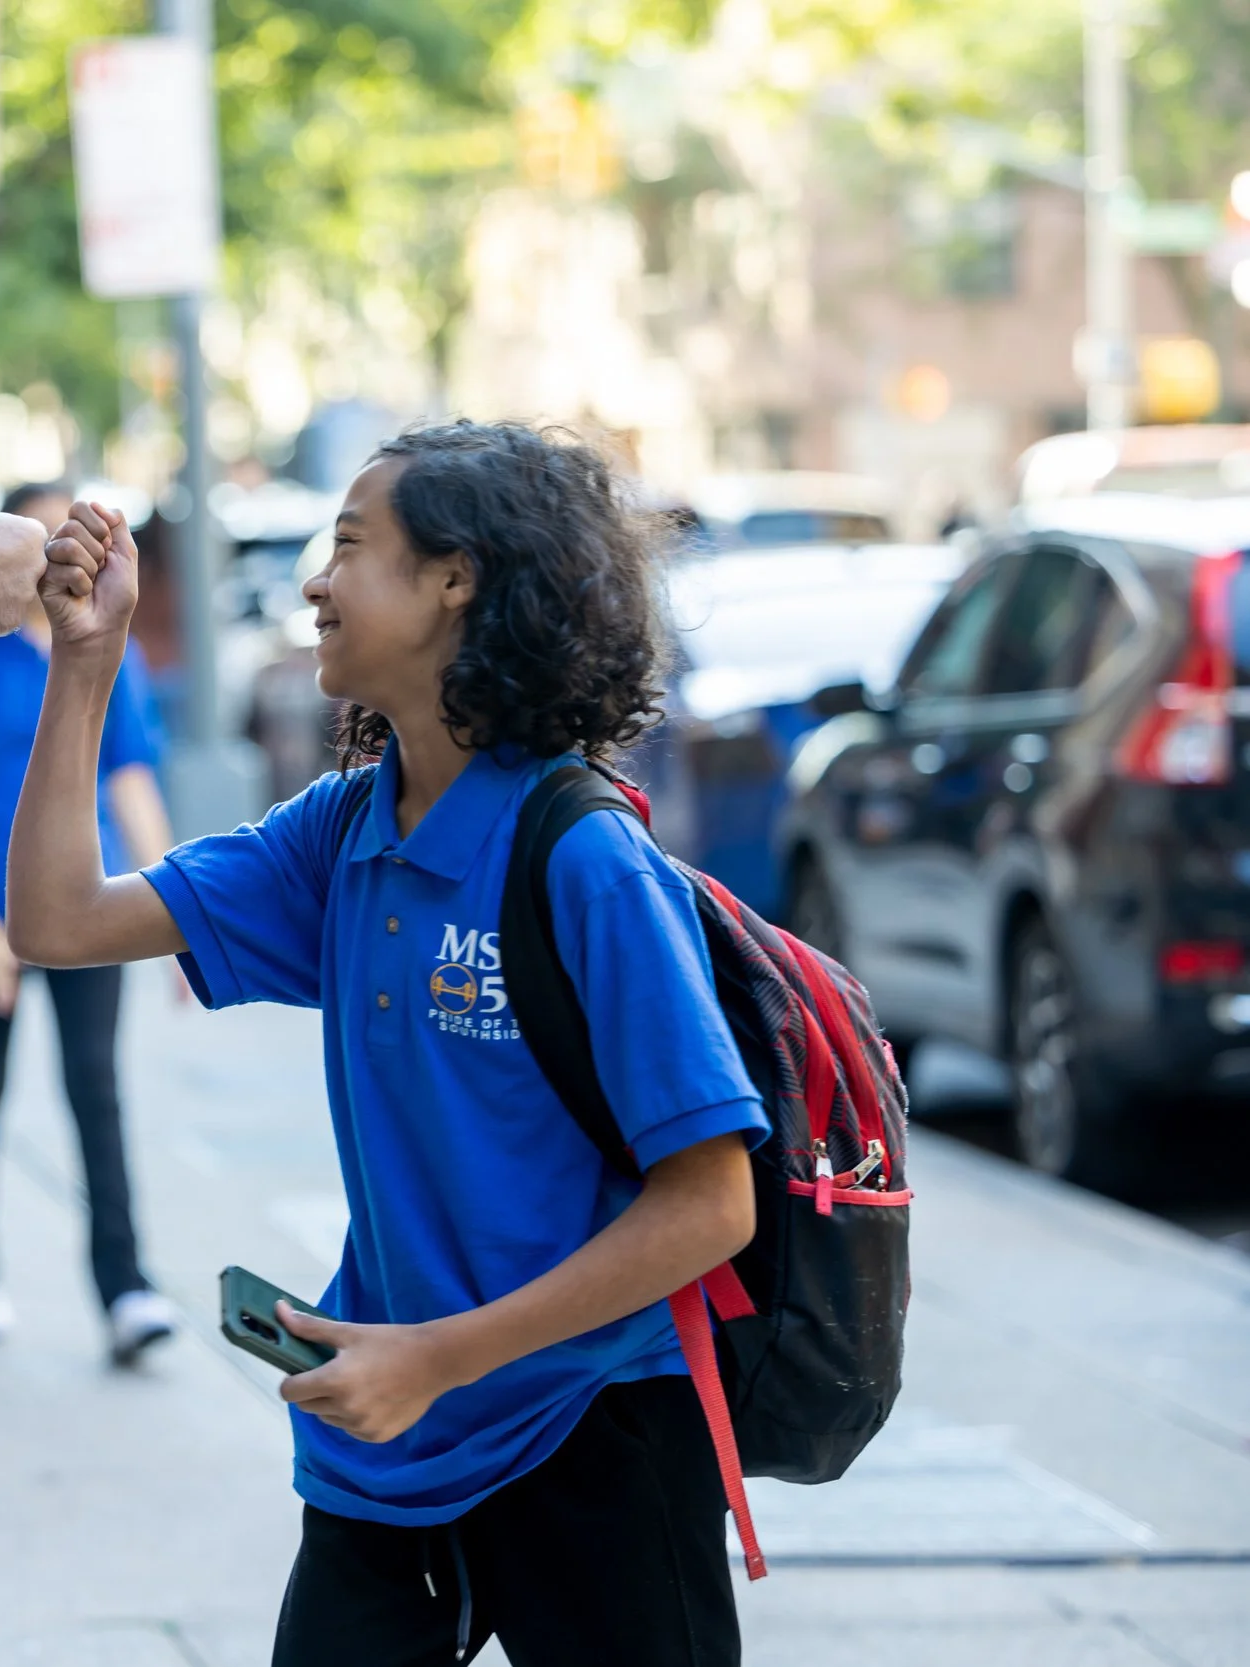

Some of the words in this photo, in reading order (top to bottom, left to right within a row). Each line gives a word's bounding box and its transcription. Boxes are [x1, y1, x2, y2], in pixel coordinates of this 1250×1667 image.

[434, 923, 502, 971] MS
[428, 1008, 473, 1029] PRIDE
[481, 1018, 502, 1029] OF
[438, 1021, 521, 1040] SOUTHSID
